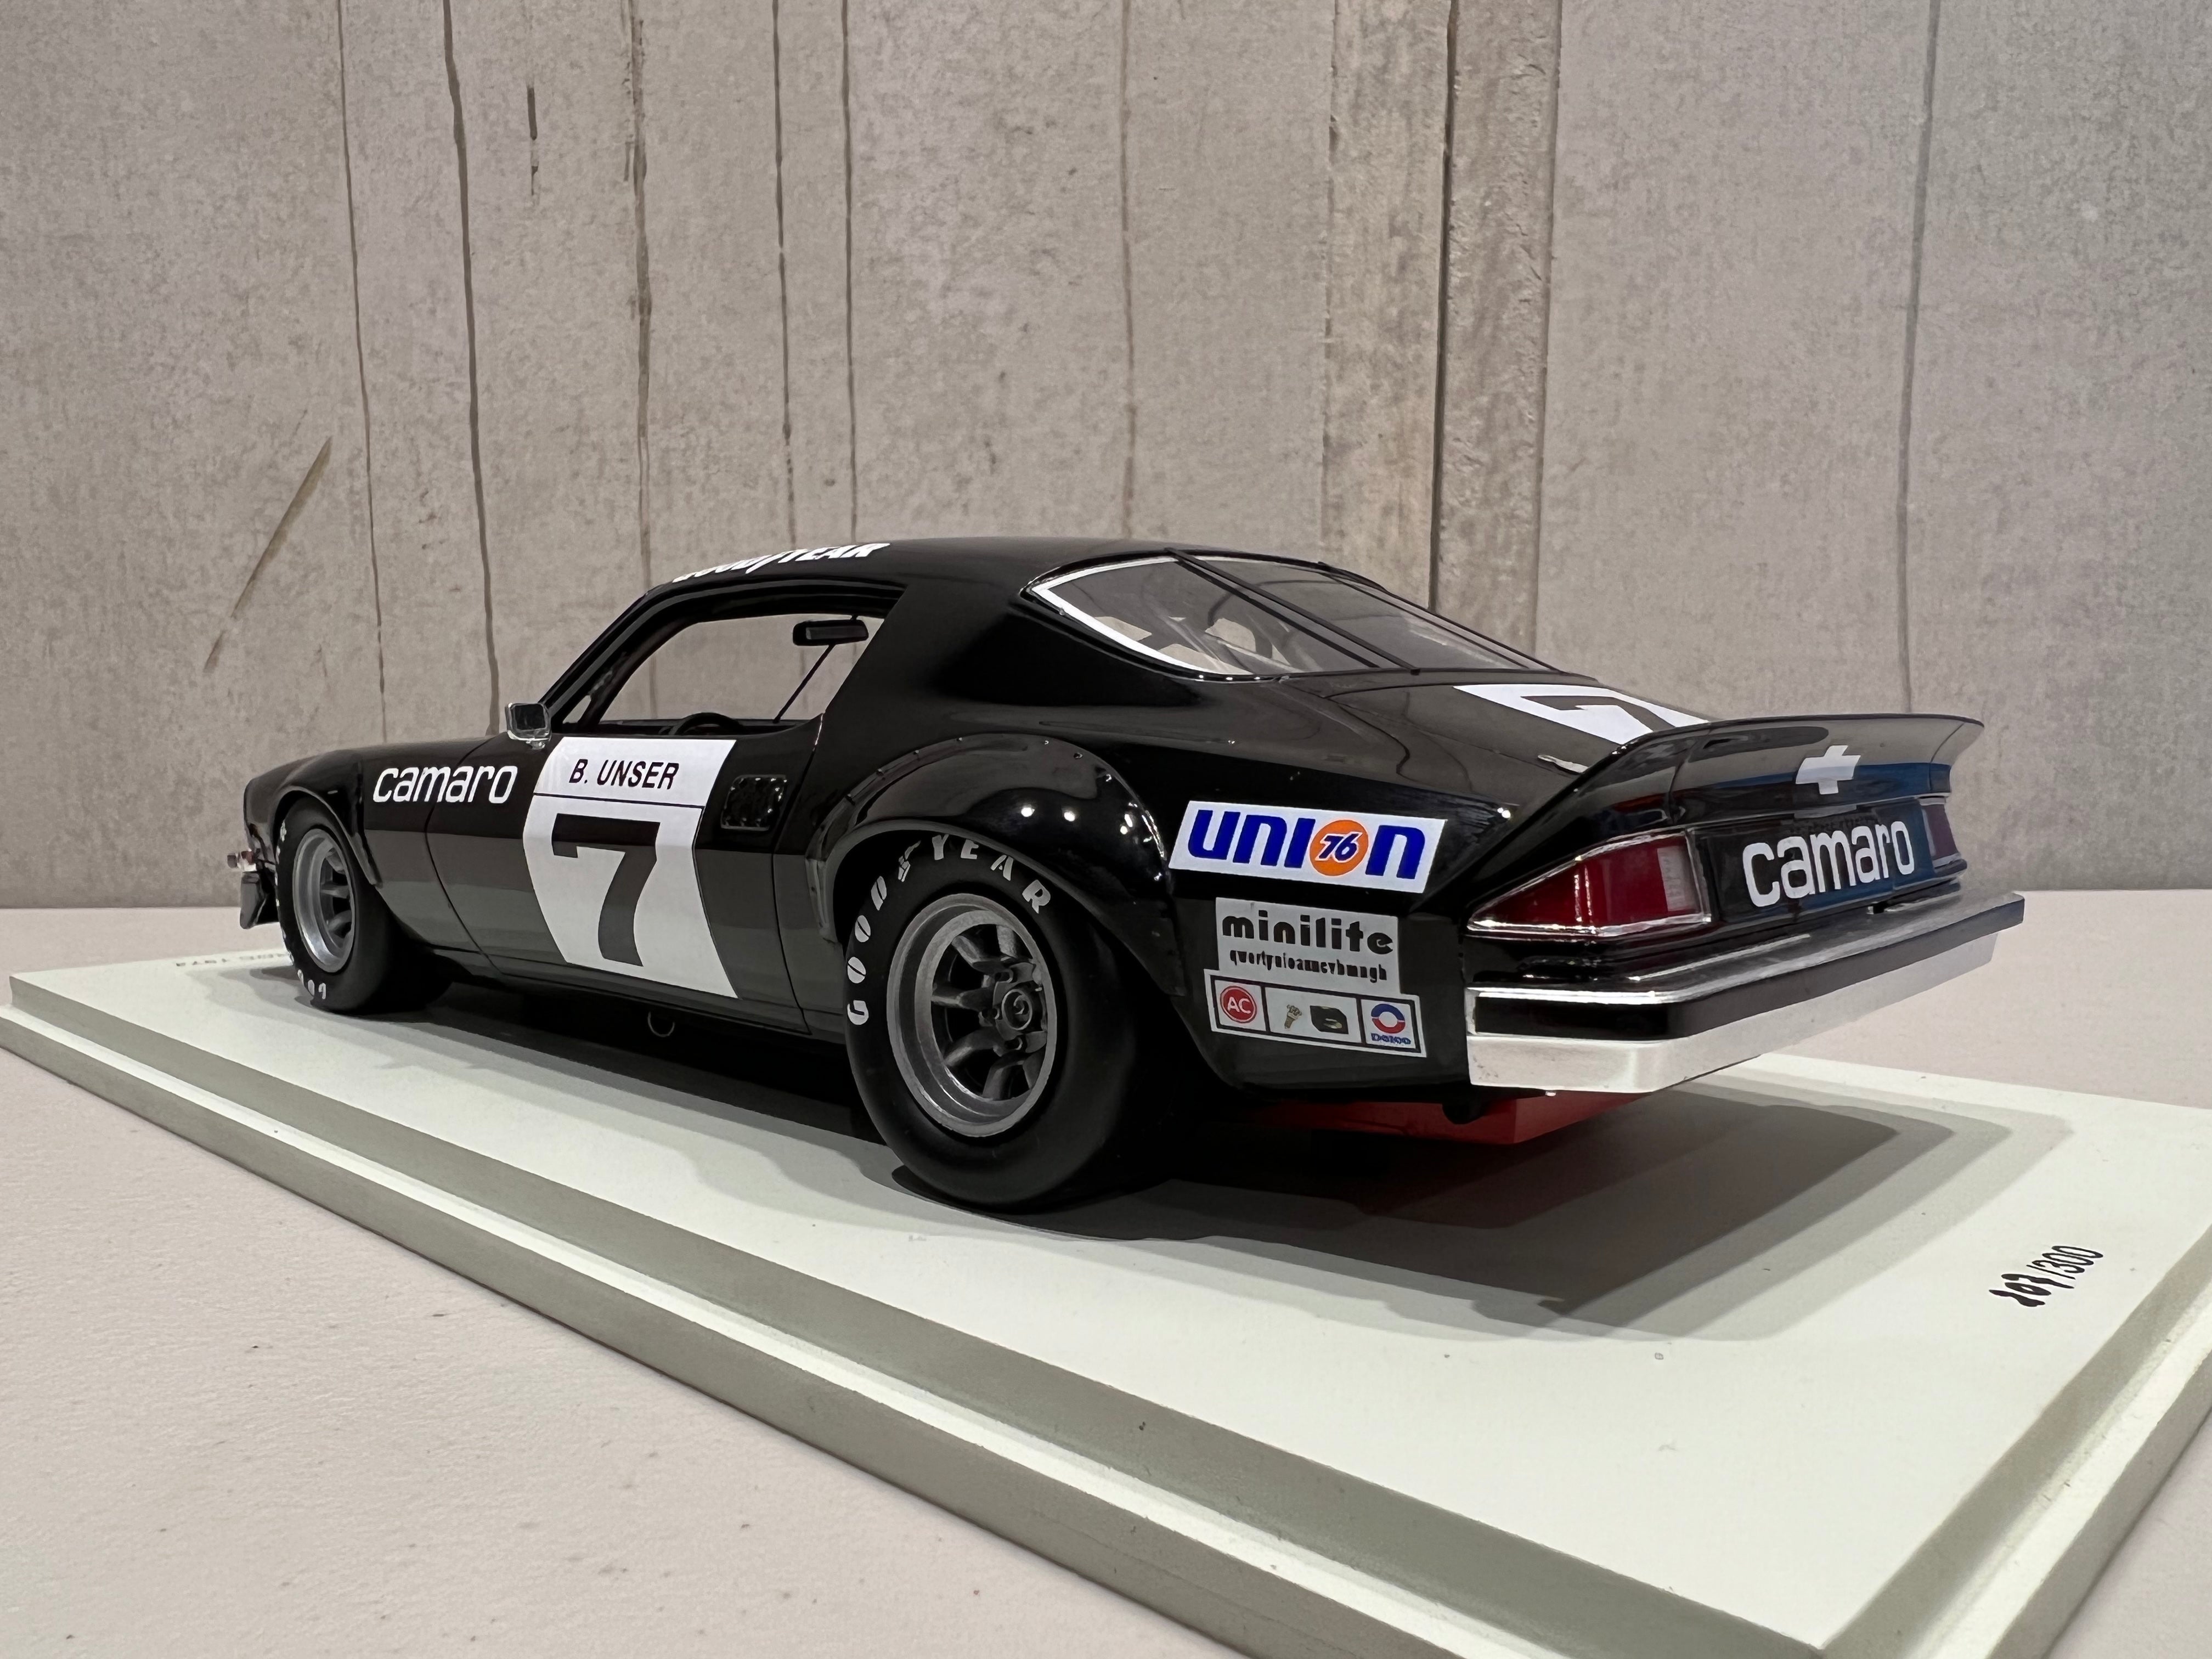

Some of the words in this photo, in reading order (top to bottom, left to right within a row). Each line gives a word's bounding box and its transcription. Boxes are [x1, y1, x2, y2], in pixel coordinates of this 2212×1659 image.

[373, 765, 518, 804] camaro
[569, 759, 588, 784] B.
[596, 759, 679, 790] UNSER
[1316, 832, 1362, 862] 76
[1742, 821, 1915, 907] camaro
[551, 813, 661, 967] 7
[1222, 910, 1393, 955] minilite
[1227, 996, 1251, 1014] AC
